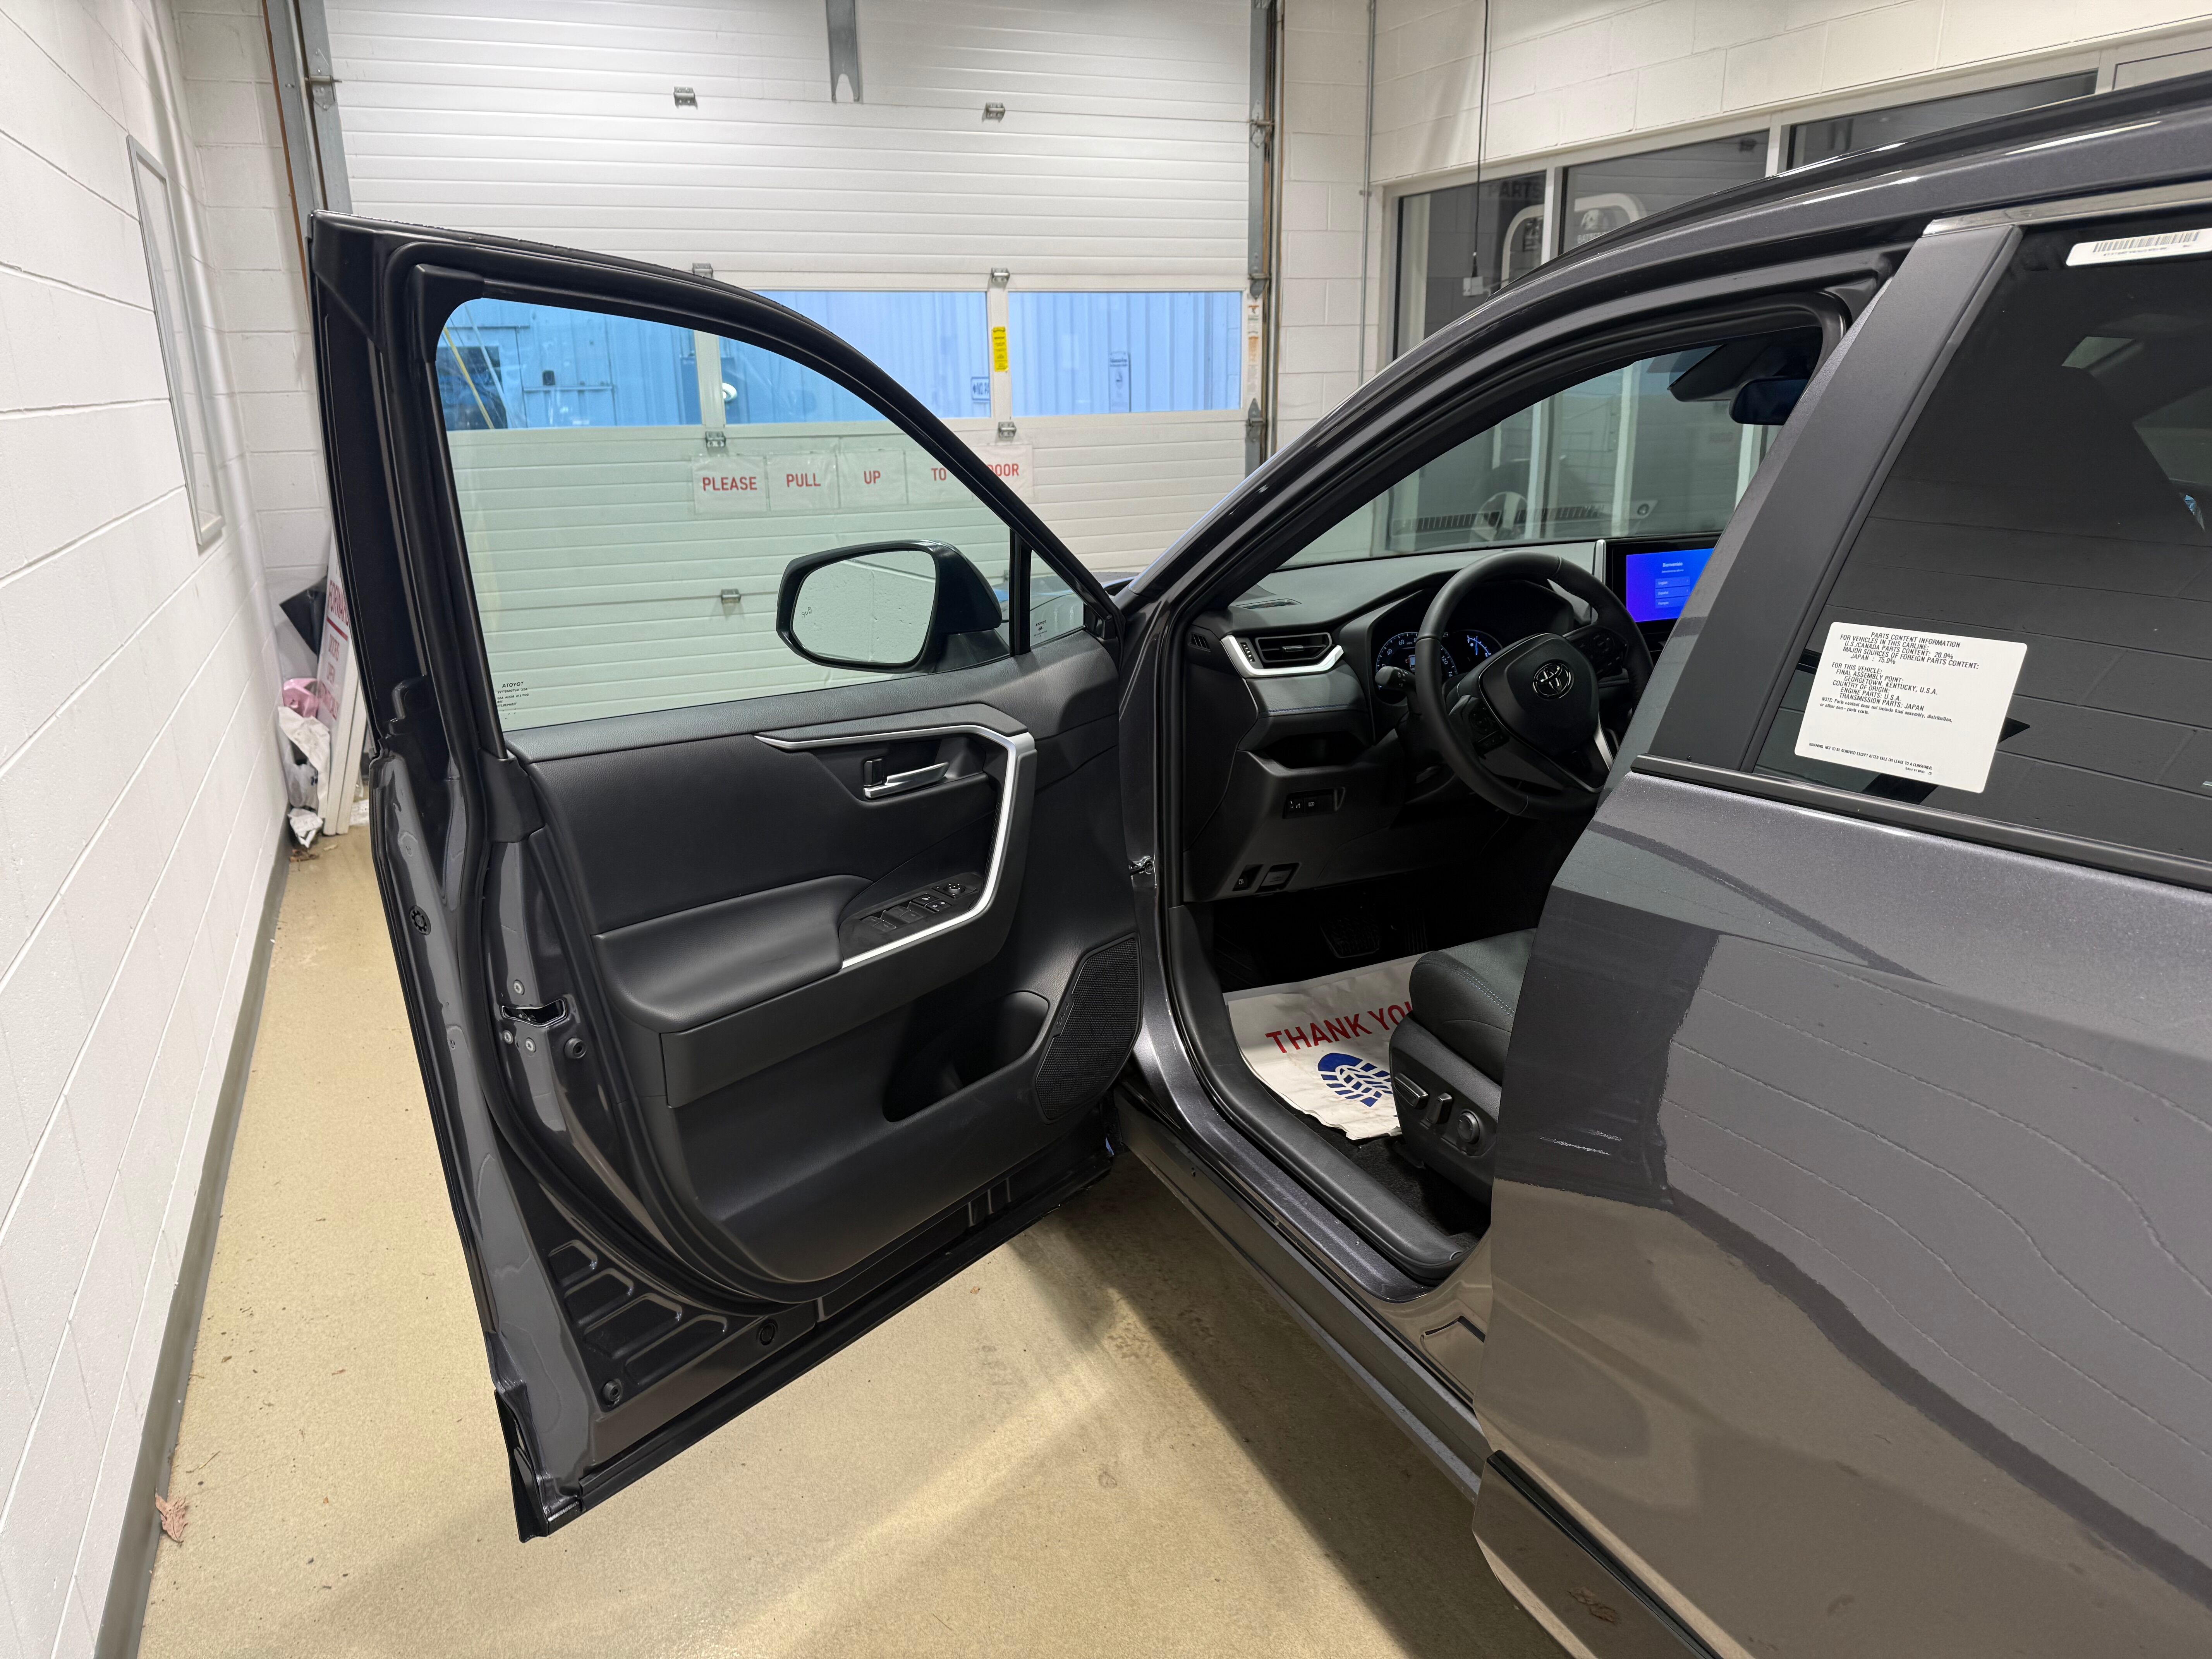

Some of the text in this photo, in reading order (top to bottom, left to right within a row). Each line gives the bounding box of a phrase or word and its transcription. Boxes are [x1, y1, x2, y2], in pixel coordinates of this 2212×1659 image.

[702, 477, 757, 491] PLEASE
[787, 474, 821, 487] PULL
[865, 471, 881, 484] UP
[931, 468, 947, 481] TO
[1853, 635, 1878, 644] VEHICLES
[1902, 642, 1929, 650] CARLINE:
[1891, 634, 1918, 642] CONTENT
[1918, 637, 1961, 648] INFORMATION
[1863, 649, 1889, 658] SOURCES
[1899, 653, 1925, 662] FOREIGN
[1926, 657, 1947, 665] PARTS
[1948, 659, 1979, 669] CONTENT:
[1902, 647, 1931, 657] CONTENT:
[1934, 651, 1953, 659] 20.0%
[1878, 656, 1896, 665] 75.0%
[1858, 666, 1882, 674] VEHICLE:
[1844, 675, 1883, 687] GEORGETOWN,
[1886, 682, 1917, 692] KENTUCKY,
[1853, 671, 1884, 680] ASSEMBLY
[1884, 675, 1904, 684] POINT:
[1832, 680, 1859, 689] COUNTRY
[1869, 685, 1890, 694] ORIGIN:
[1840, 687, 1861, 695] ENGINE
[1862, 690, 1882, 699] PARTS:
[1839, 692, 1924, 711] TRANSMISSION PARTS: JAPAN
[1265, 1013, 1372, 1053] THANK
